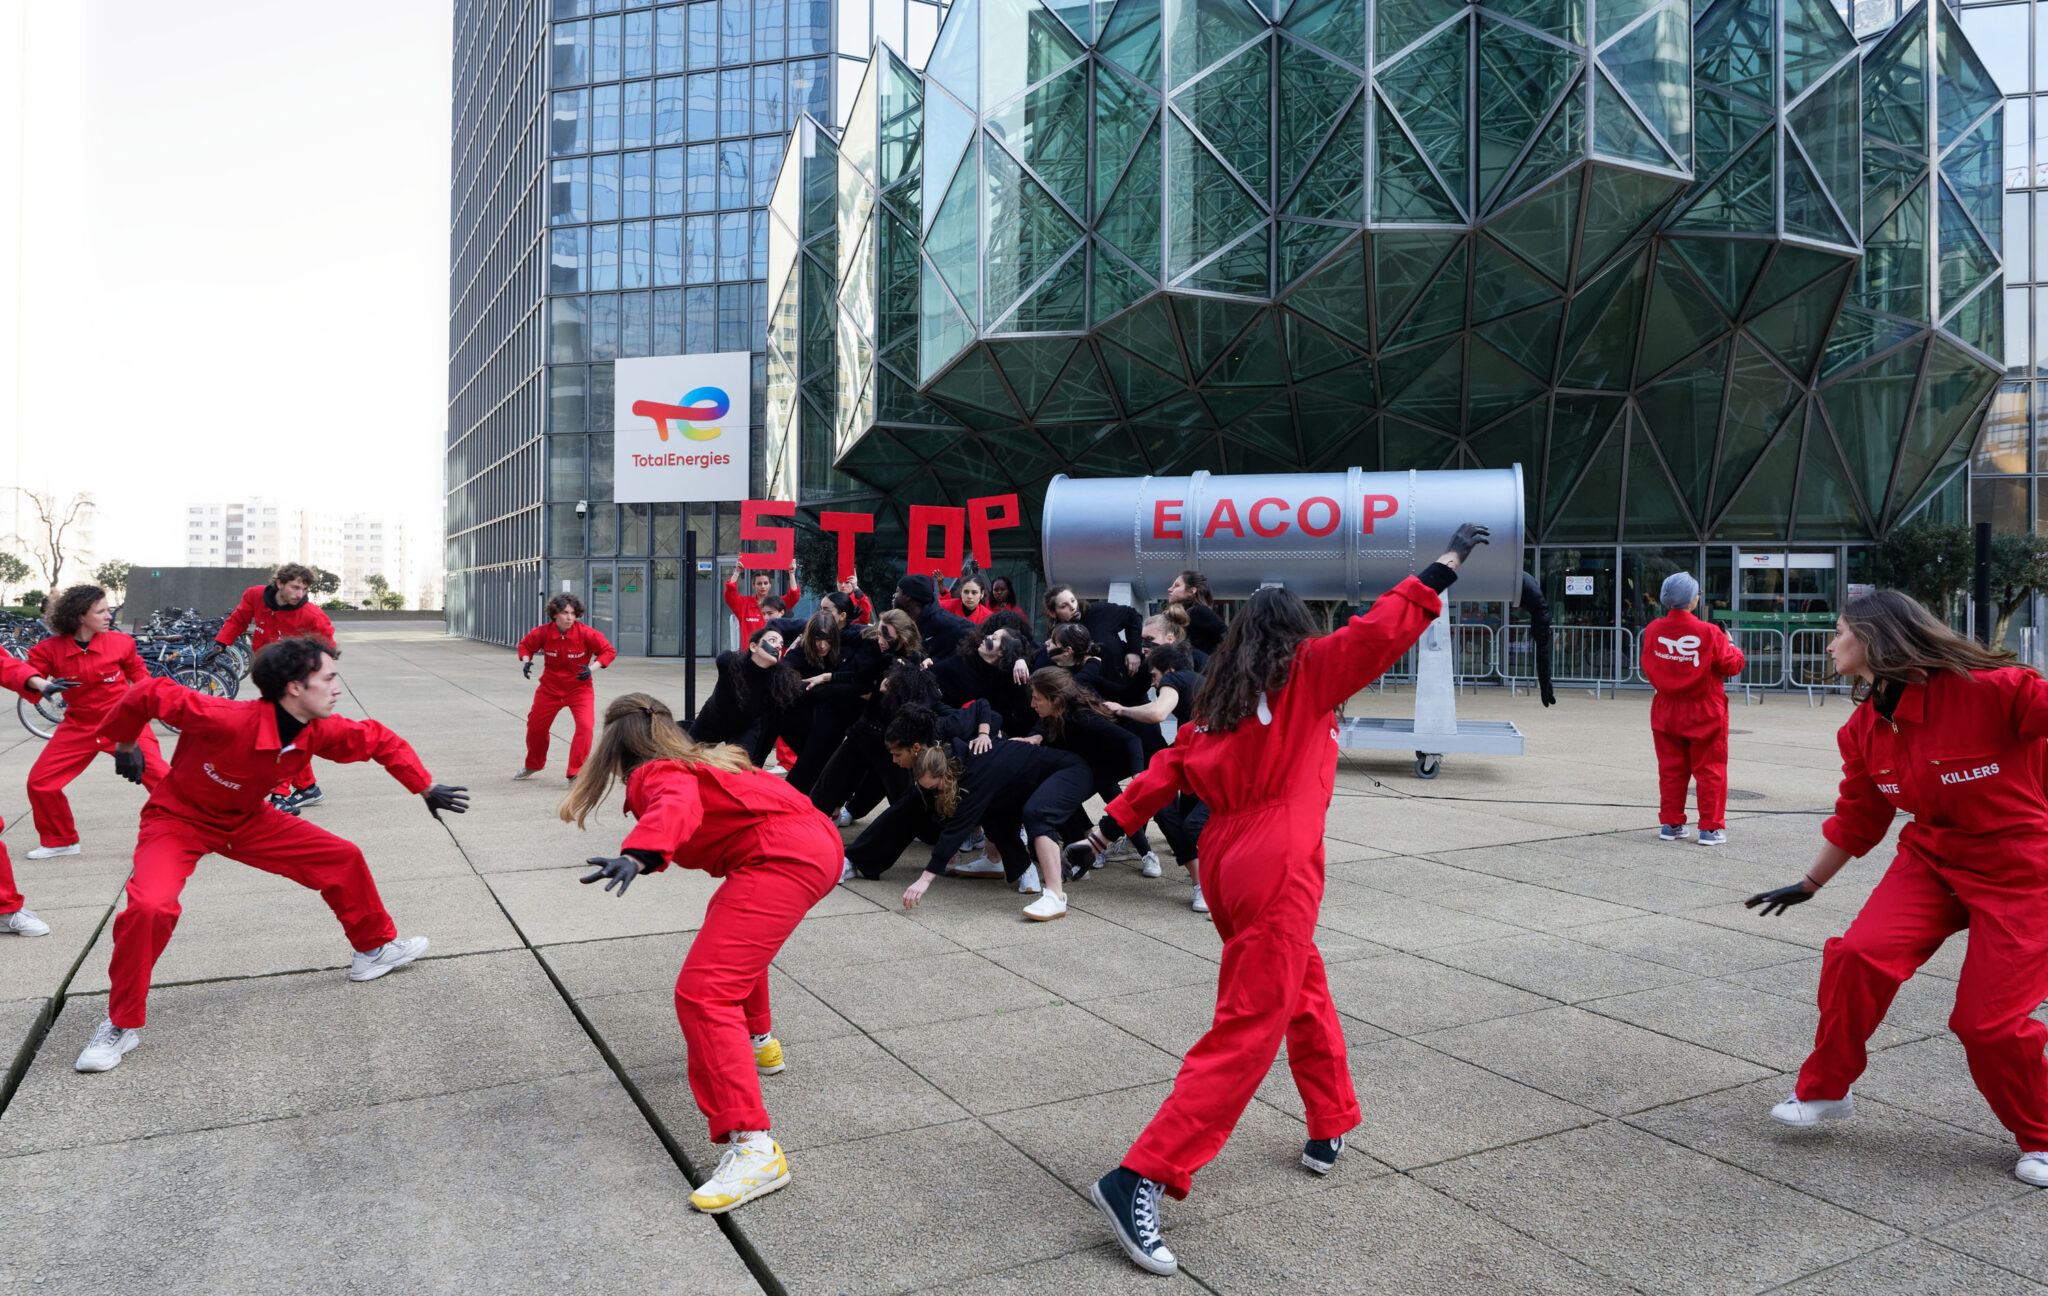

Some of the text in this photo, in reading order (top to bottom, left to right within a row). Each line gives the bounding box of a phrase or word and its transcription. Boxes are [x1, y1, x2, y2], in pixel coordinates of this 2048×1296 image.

[632, 451, 730, 469] TotalEnergies
[1153, 494, 1399, 539] EACOP
[739, 493, 1020, 583] STOP
[1940, 763, 2000, 785] KILLERS
